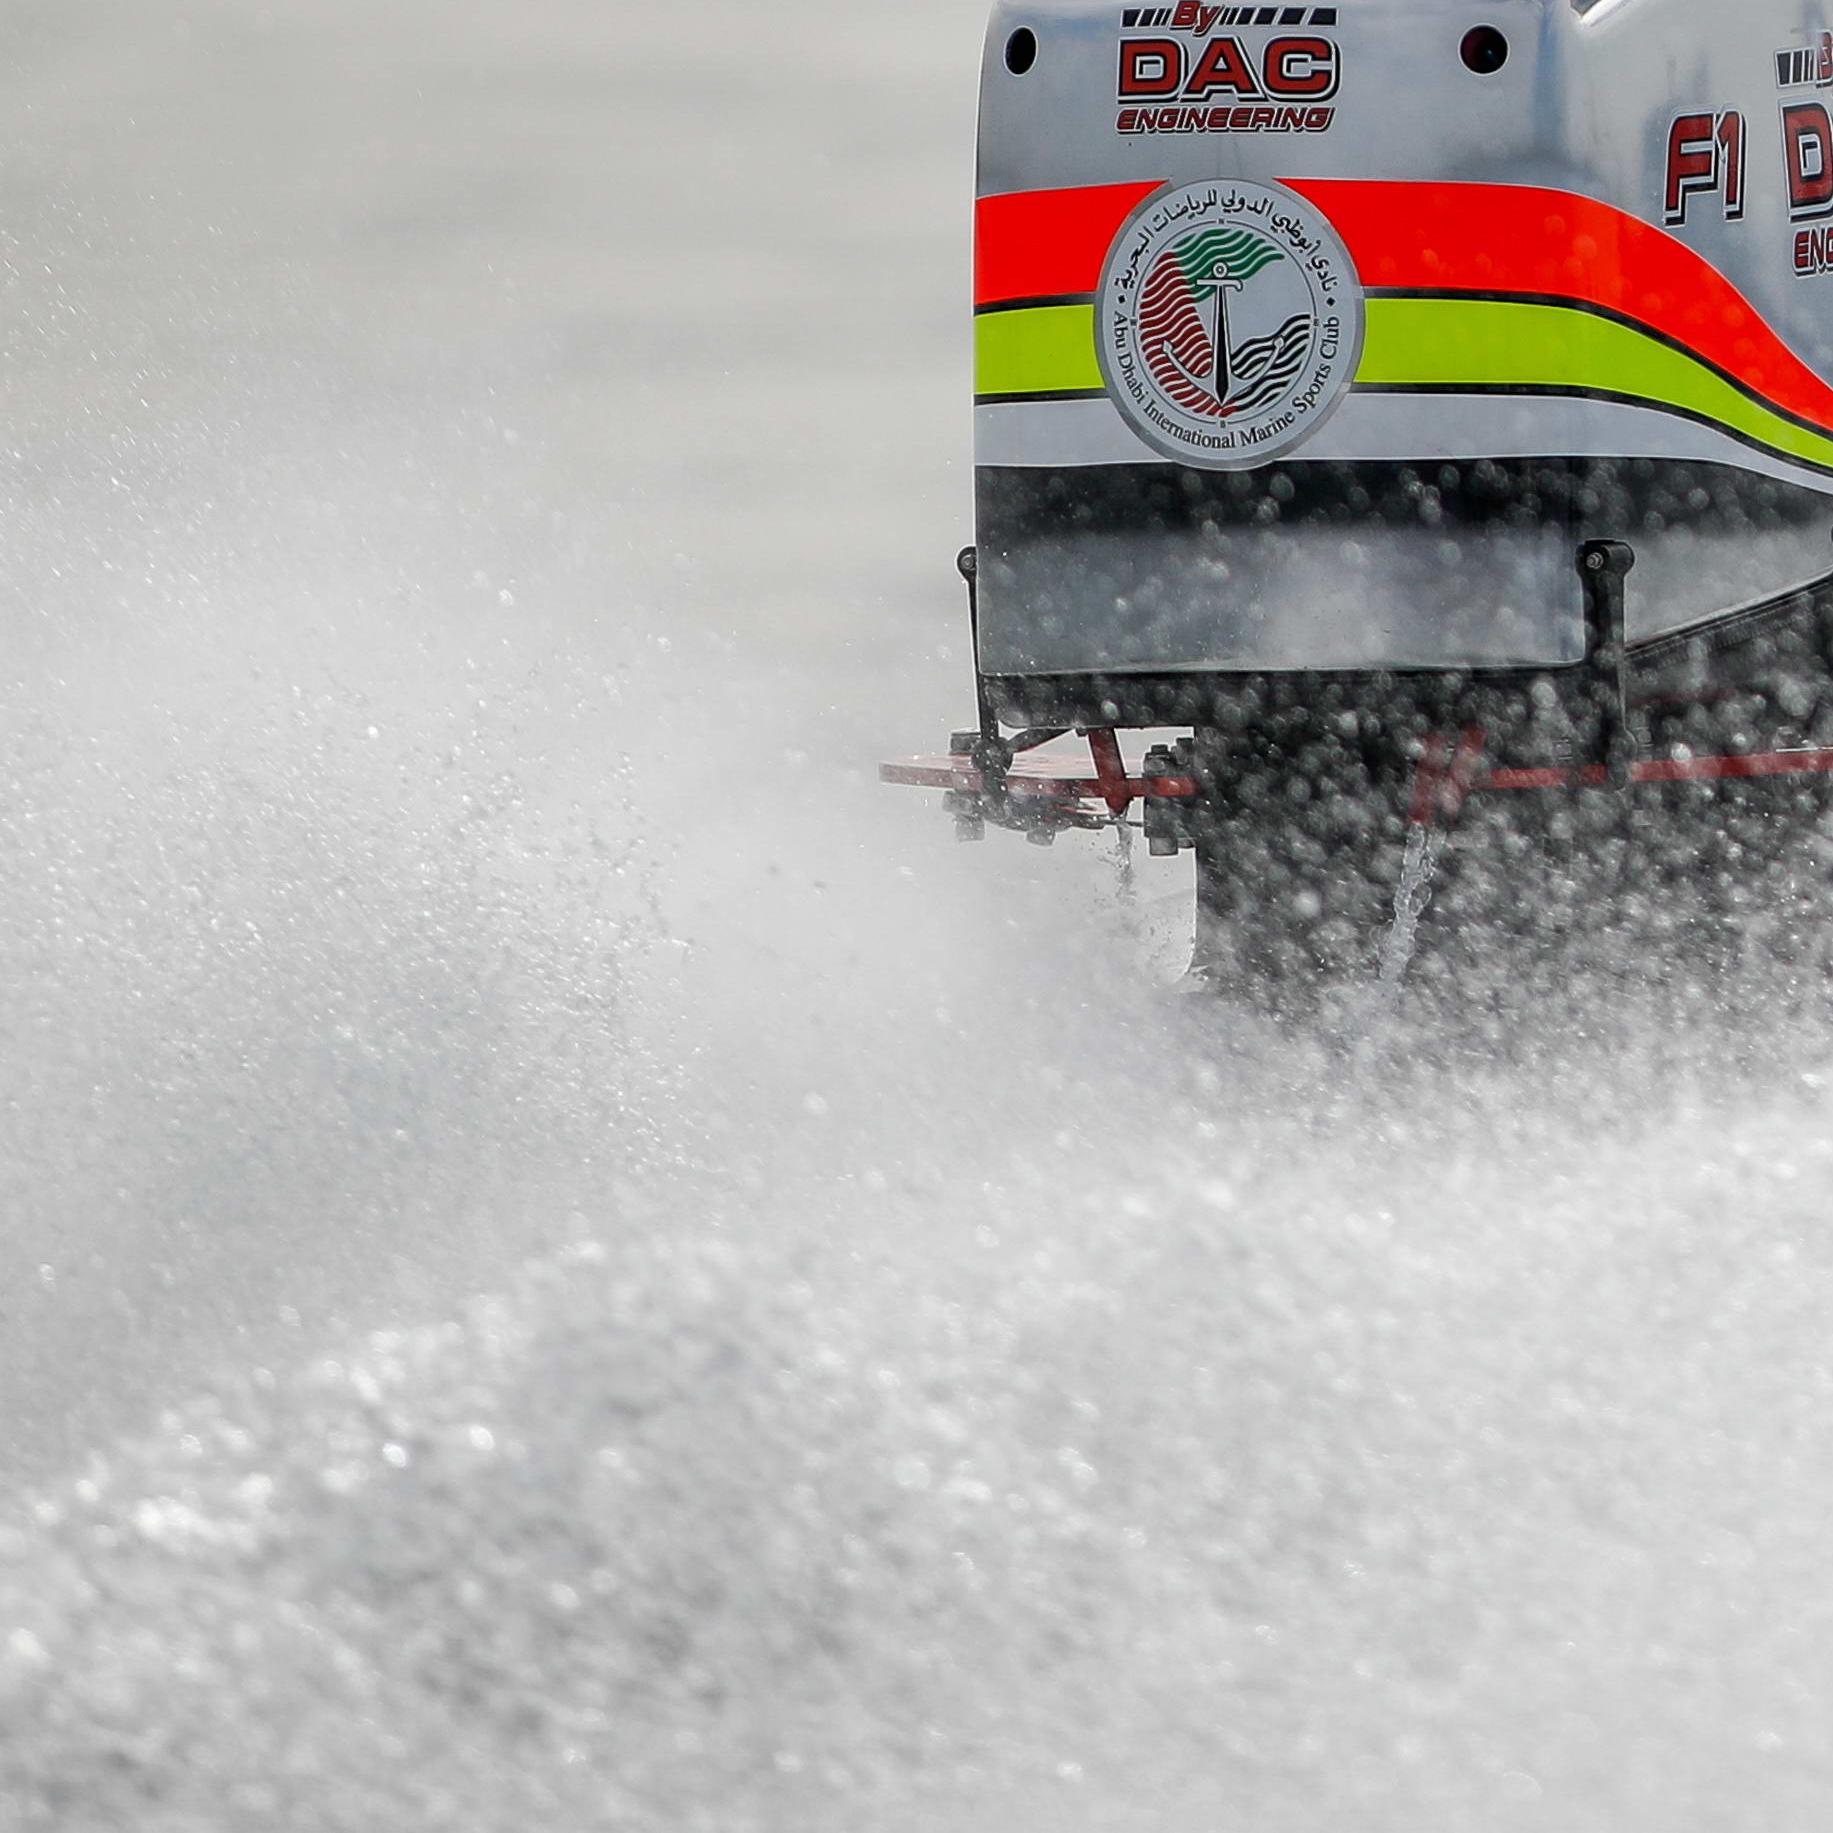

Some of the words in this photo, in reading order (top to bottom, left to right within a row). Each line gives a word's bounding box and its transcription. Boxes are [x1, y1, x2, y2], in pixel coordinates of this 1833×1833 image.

[1169, 0, 1223, 36] By
[1117, 36, 1341, 103] DAC
[1116, 106, 1336, 134] ENGINEERING
[1664, 108, 1747, 226] F1
[1152, 188, 1217, 232] للرياضات
[1221, 188, 1274, 215] الدولي
[1113, 225, 1154, 290] البحرية
[1305, 253, 1341, 293] نادي
[1113, 310, 1128, 351] Abu
[1319, 316, 1341, 360] Club
[1117, 352, 1150, 405] Dhabi
[1291, 363, 1332, 415] Sports
[1143, 399, 1236, 449] International
[1240, 411, 1295, 448] Marine
